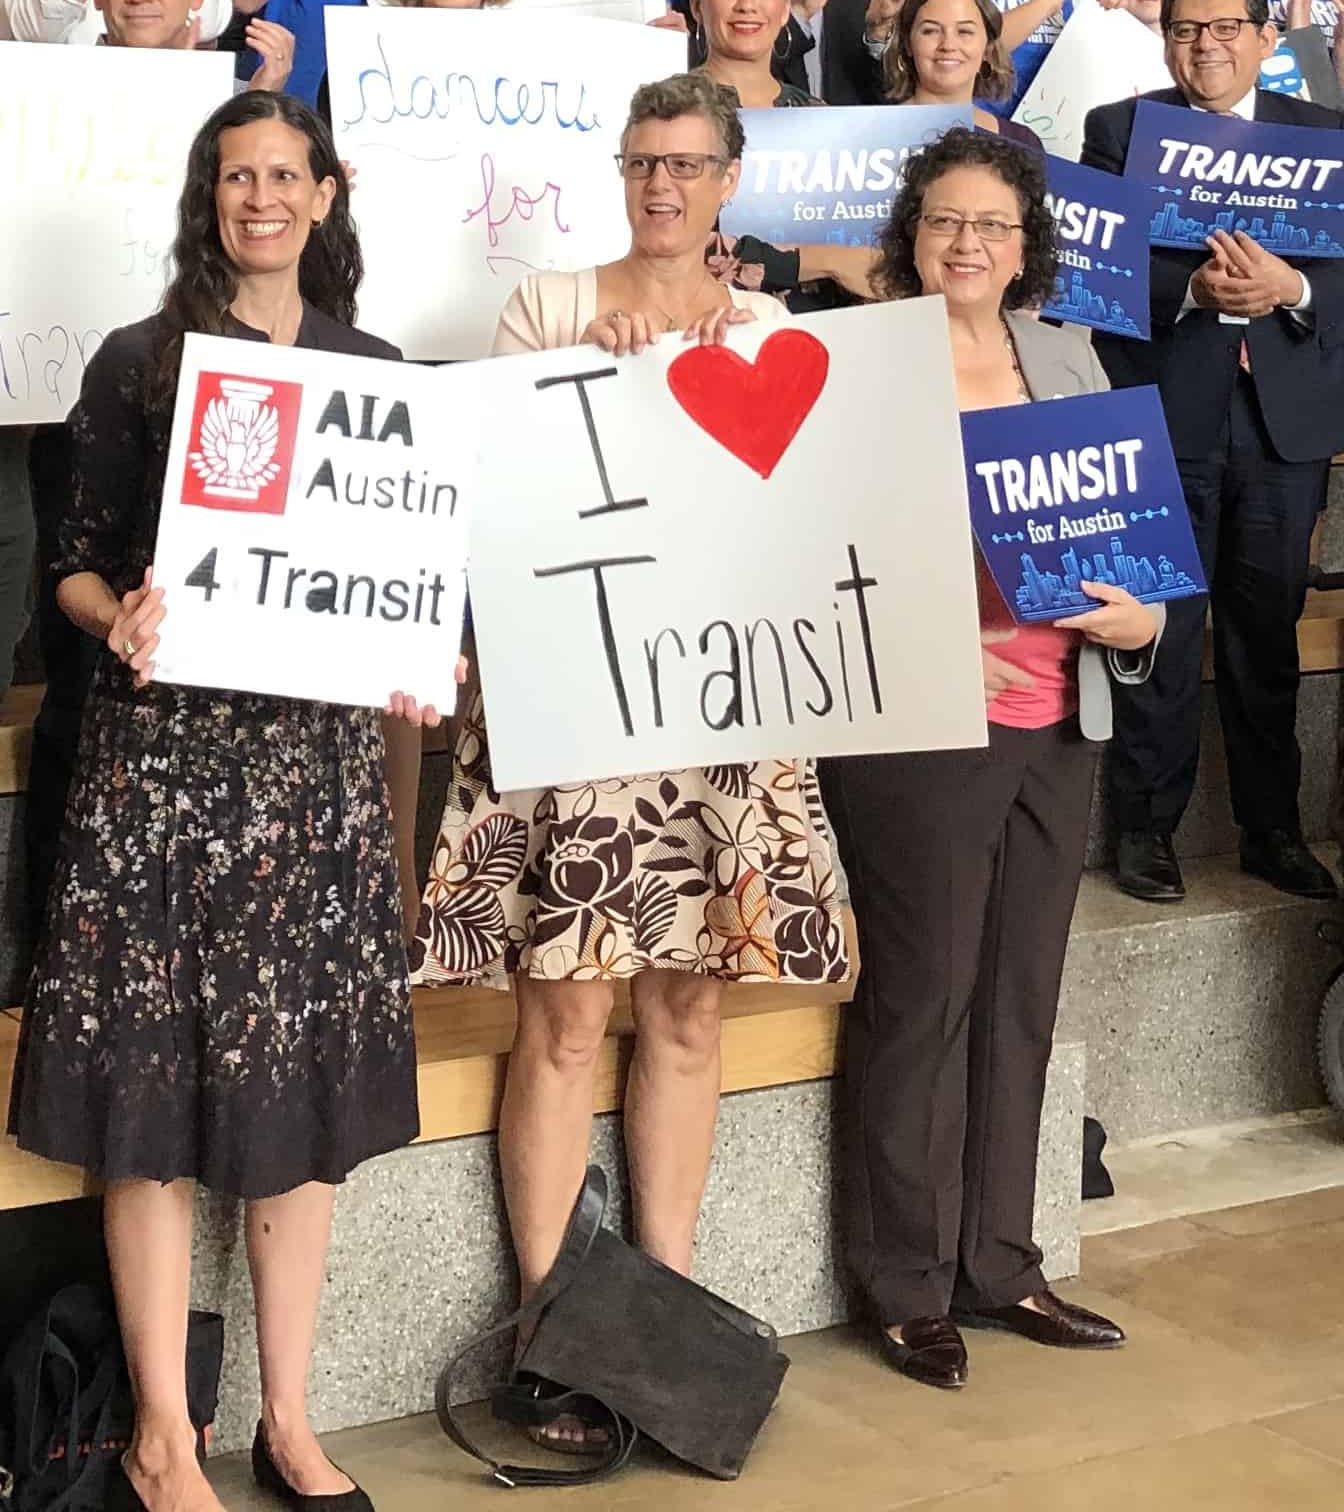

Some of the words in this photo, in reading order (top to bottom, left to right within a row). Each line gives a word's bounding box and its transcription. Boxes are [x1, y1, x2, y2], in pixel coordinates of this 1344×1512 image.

[1158, 138, 1343, 191] TRANSIT
[462, 153, 570, 250] for
[793, 200, 824, 221] for
[831, 200, 893, 220] Austi
[1190, 185, 1221, 203] for
[1225, 190, 1298, 209] Austin
[315, 389, 414, 448] AIA
[535, 366, 648, 519] I
[306, 458, 458, 518] Austin
[975, 439, 1142, 515] TRANSIT
[1027, 519, 1055, 544] for
[1059, 508, 1127, 540] Austin
[184, 546, 220, 602] 4
[248, 546, 445, 626] Transit
[533, 544, 878, 737] Transit
